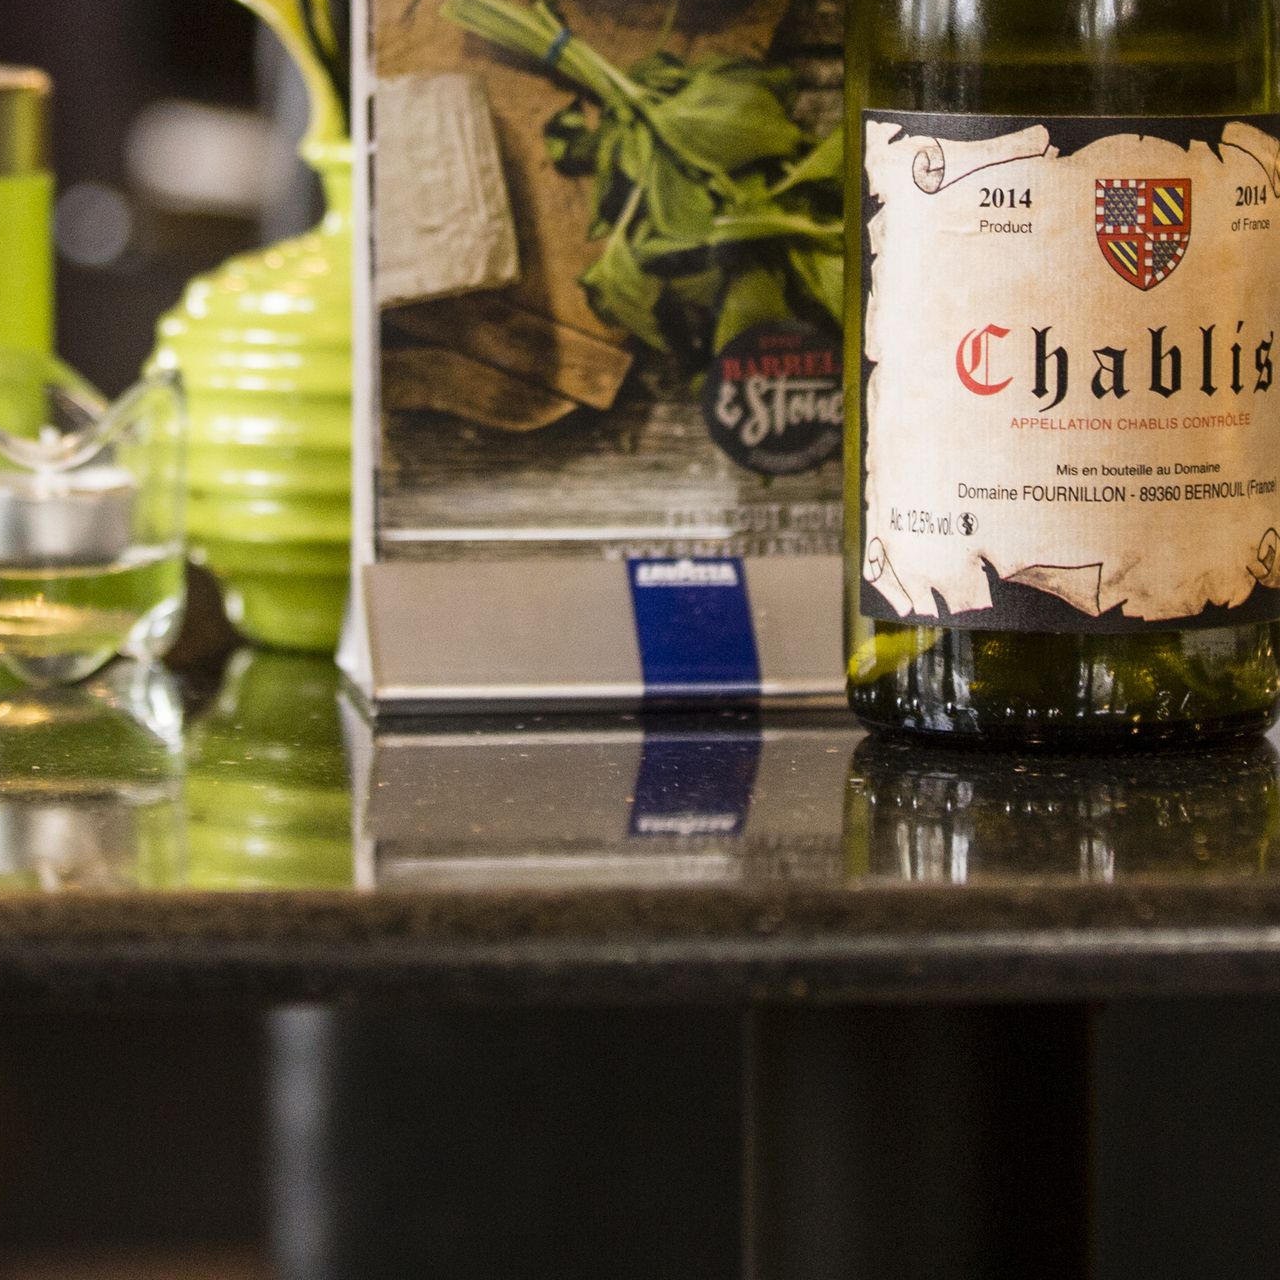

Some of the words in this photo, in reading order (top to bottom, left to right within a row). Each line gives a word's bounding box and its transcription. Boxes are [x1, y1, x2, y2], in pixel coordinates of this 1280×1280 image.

[979, 186, 1033, 209] 2014
[1235, 184, 1268, 207] 2014
[979, 219, 1033, 235] Product
[1231, 220, 1241, 232] of
[1242, 218, 1271, 233] France
[955, 320, 1275, 413] Chablis
[1009, 417, 1112, 431] APPELLATION
[1117, 417, 1179, 431] CHABLIS
[1183, 412, 1251, 429] CONTRÔLÉE
[1056, 463, 1078, 476] Mis
[1082, 466, 1098, 476] en
[1101, 464, 1154, 477] bouteille
[1156, 464, 1172, 476] au
[1174, 462, 1221, 475] Domaine
[957, 482, 1019, 501] Domaine
[1022, 485, 1126, 503] FOURNILLON
[1139, 485, 1181, 502] 89360
[1184, 481, 1246, 501] BERNOUIL
[889, 507, 904, 531] Alc.
[907, 509, 935, 536] 12,5%
[937, 512, 954, 536] vol.
